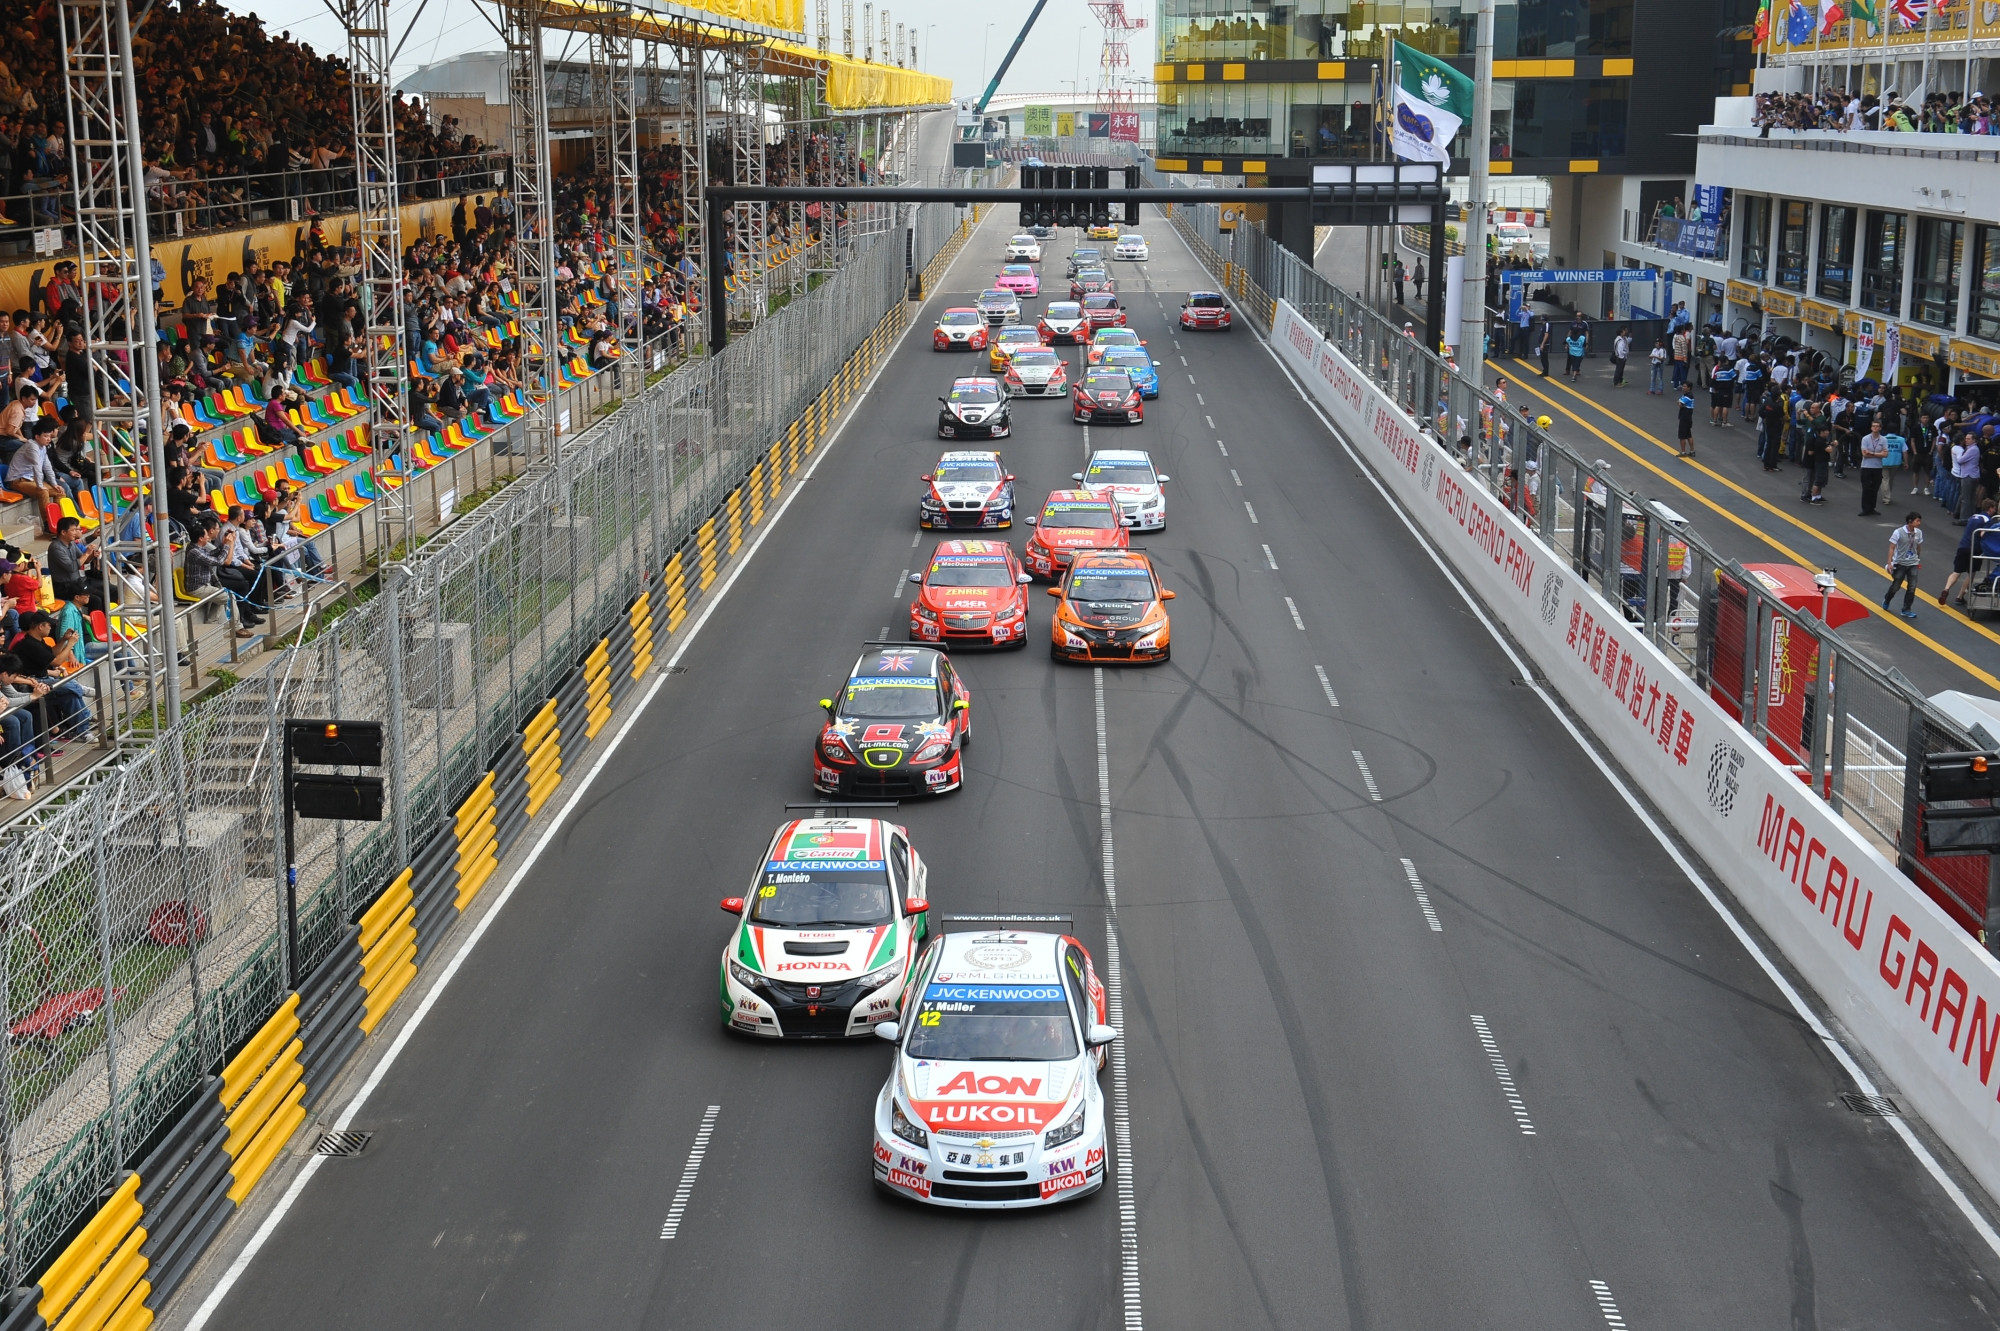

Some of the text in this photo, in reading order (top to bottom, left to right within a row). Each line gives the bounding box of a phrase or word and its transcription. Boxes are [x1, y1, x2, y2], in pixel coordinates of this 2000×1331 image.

[1113, 115, 1137, 133] 永利
[1224, 208, 1236, 222] 6
[1554, 271, 1604, 281] WINNER
[1903, 358, 1908, 366] 5
[1350, 380, 1364, 414] PRIX
[1436, 469, 1535, 598] MACAU GRAND PRIX
[924, 627, 938, 635] KW
[995, 628, 1010, 636] KW
[1068, 638, 1083, 646] KW
[1566, 599, 1695, 767] 澳門格蘭披治大賽車
[847, 692, 855, 701] 1
[1730, 748, 1745, 769] GRAND
[1727, 760, 1738, 779] PRIX
[823, 772, 838, 782] KW
[930, 773, 945, 781] KW
[1725, 774, 1740, 796] MACAU
[809, 850, 855, 858] Castrol
[768, 873, 810, 884] T. Monteiro
[758, 886, 777, 898] 18
[953, 914, 1061, 922] www.rmlmallock.co.uk
[1757, 792, 2000, 1104] MACAU GRAN
[776, 961, 852, 972] HONDA
[739, 999, 760, 1011] KW
[869, 998, 890, 1011] KW
[924, 1002, 976, 1012] Y. Muller
[737, 1012, 760, 1023] brose
[867, 1012, 893, 1022] brose
[918, 1011, 942, 1026] 12
[936, 1071, 1042, 1097] AON
[929, 1105, 1043, 1124] LUKOIL
[873, 1140, 893, 1163] AON
[900, 1156, 927, 1175] KW
[1048, 1156, 1075, 1176] KW
[890, 1171, 930, 1191] LUKOIL
[1042, 1173, 1085, 1193] LUKOIL
